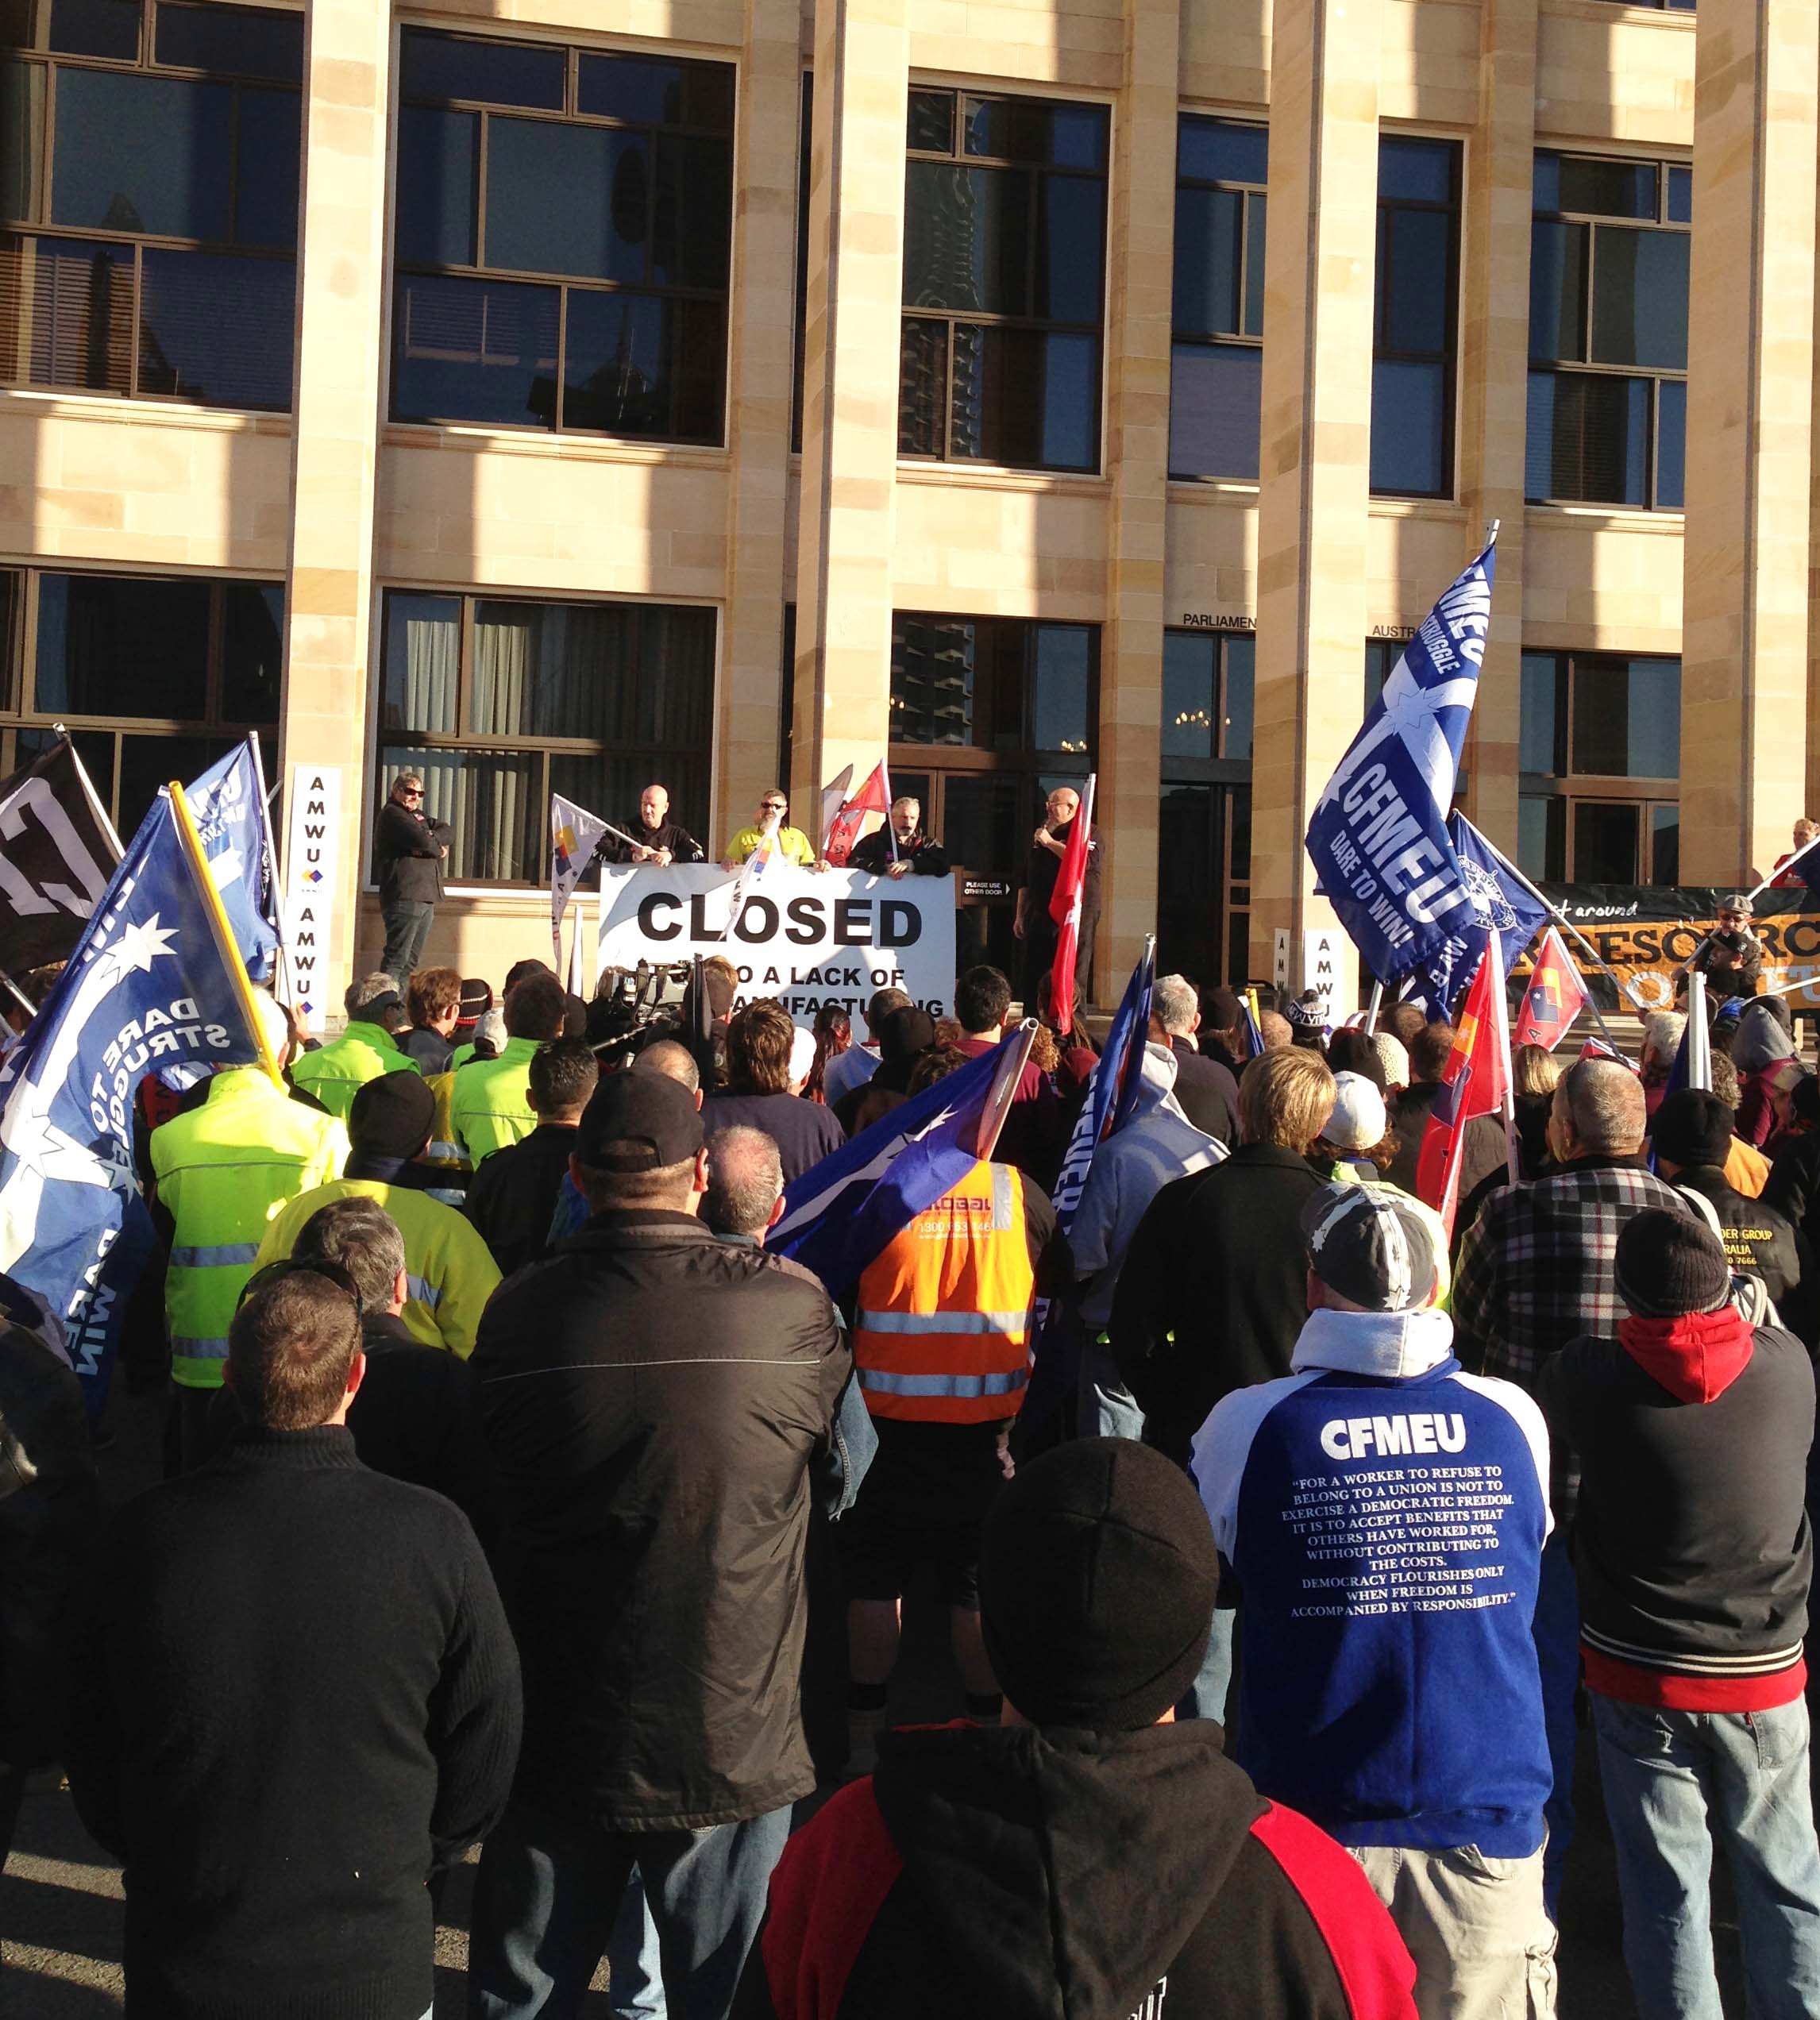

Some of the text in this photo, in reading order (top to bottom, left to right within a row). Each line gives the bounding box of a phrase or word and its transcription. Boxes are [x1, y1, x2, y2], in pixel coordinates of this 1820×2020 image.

[1183, 614, 1416, 638] PARLIAMEN AUSTR
[1439, 564, 1491, 667] FMEU
[305, 777, 326, 862] AMWU
[1343, 763, 1471, 923] CFMEU
[1329, 830, 1361, 878] DARE
[1351, 869, 1377, 900] TO
[1367, 892, 1415, 950] WIN!
[638, 892, 922, 947] CLOSED
[1575, 901, 1638, 917] around
[295, 908, 315, 993] AMWU
[737, 966, 904, 987] O A LACK OF
[1276, 937, 1285, 992] AMW
[1741, 1229, 1772, 1240] GROUP
[1724, 1244, 1752, 1255] RALIA
[1321, 1413, 1467, 1460] CFMEU
[1331, 1477, 1340, 1486] A
[1344, 1470, 1405, 1485] WORKER
[1408, 1468, 1428, 1479] TO
[1432, 1467, 1483, 1478] REFUSE
[1484, 1466, 1502, 1477] TO
[1294, 1480, 1503, 1505] BELONG TO A UNION IS NOT TO
[1282, 1494, 1514, 1521] EXERCISE A DEMOCRATIC FREEDOM.
[1293, 1509, 1504, 1534] IT IS TO ACCEPT BENEFITS THAT
[1308, 1524, 1497, 1546] OTHERS HAVE WORKED FOR,
[1307, 1538, 1499, 1559] WITHOUT CONTRIBUTING TO
[1369, 1556, 1448, 1571] THE COSTS.
[1302, 1566, 1505, 1589] DEMOCRACY FLOURISHES ONLY
[1347, 1584, 1473, 1601] WHEN FREEDOM IS
[1291, 1603, 1388, 1617] ACCOMPANIED
[1391, 1602, 1409, 1613] BY
